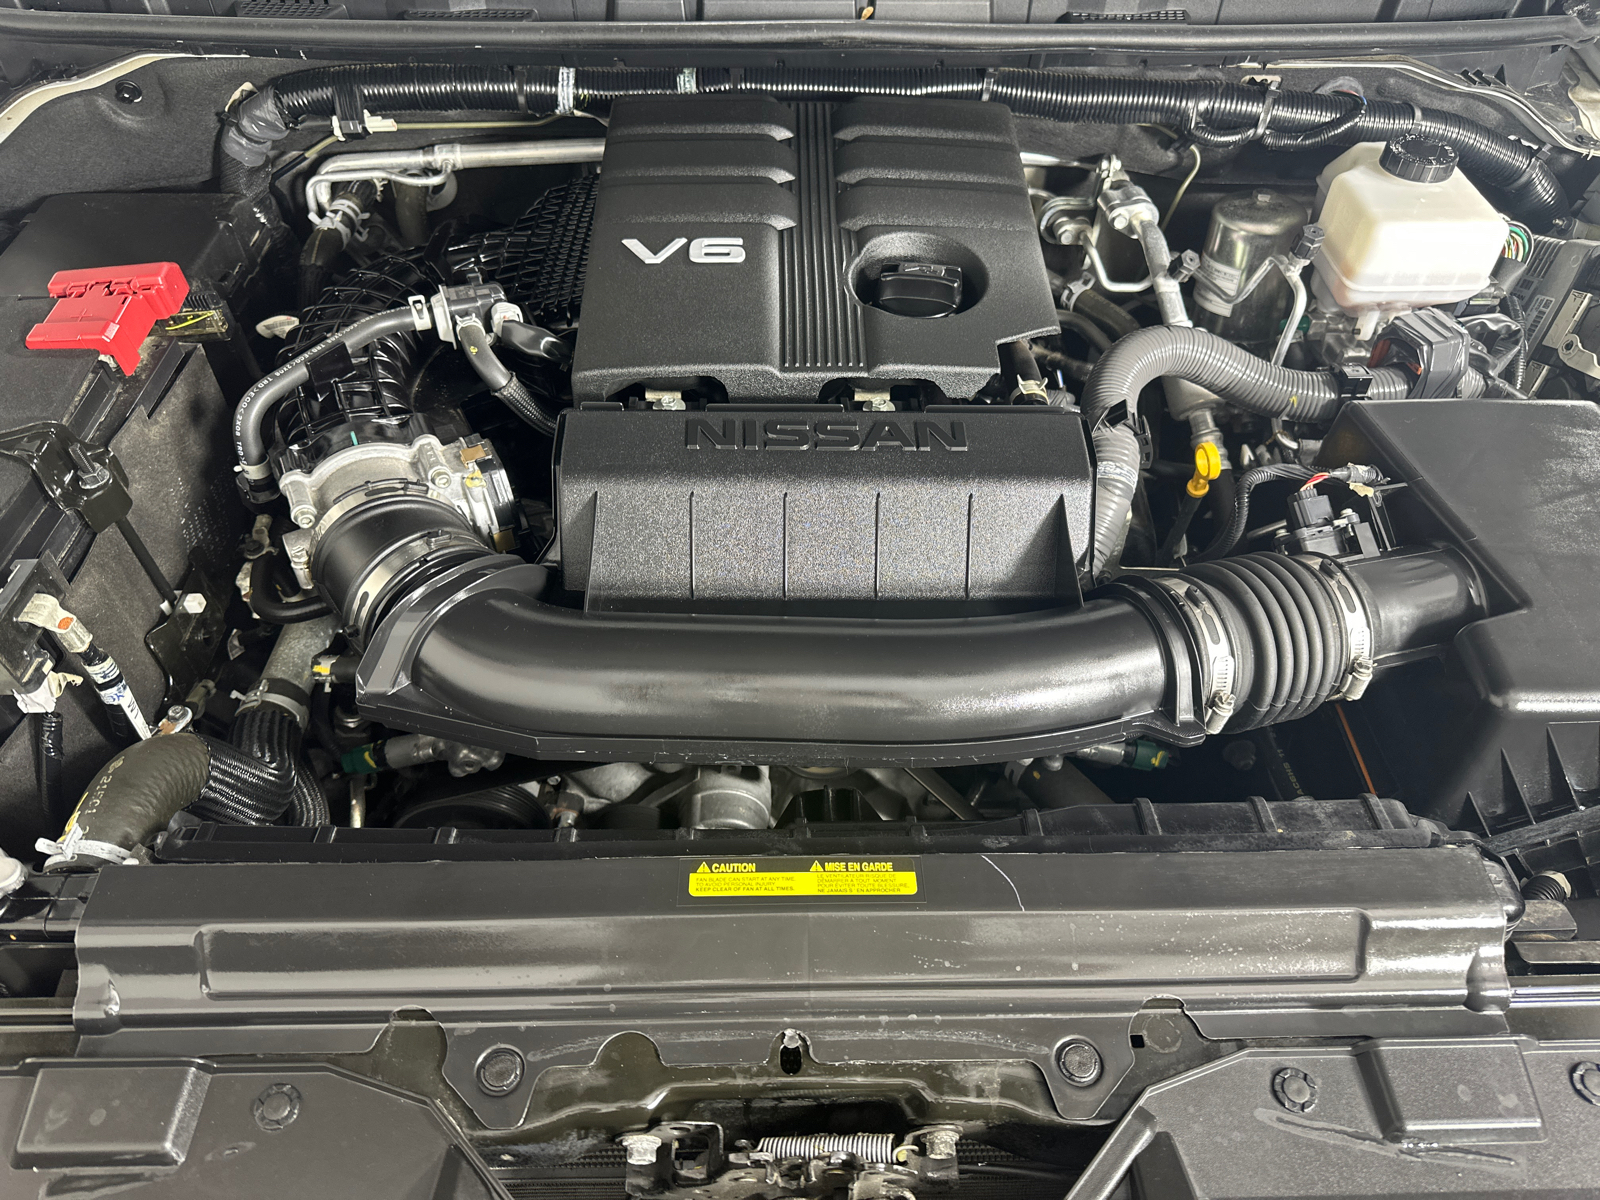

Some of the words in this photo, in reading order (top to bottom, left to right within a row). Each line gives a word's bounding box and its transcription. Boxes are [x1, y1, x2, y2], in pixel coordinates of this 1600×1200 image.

[621, 237, 746, 264] V6
[685, 420, 968, 451] NISSAN
[711, 863, 756, 873] CAUTION
[824, 862, 847, 872] MISE
[847, 862, 861, 872] EN
[861, 862, 894, 872] GARDE
